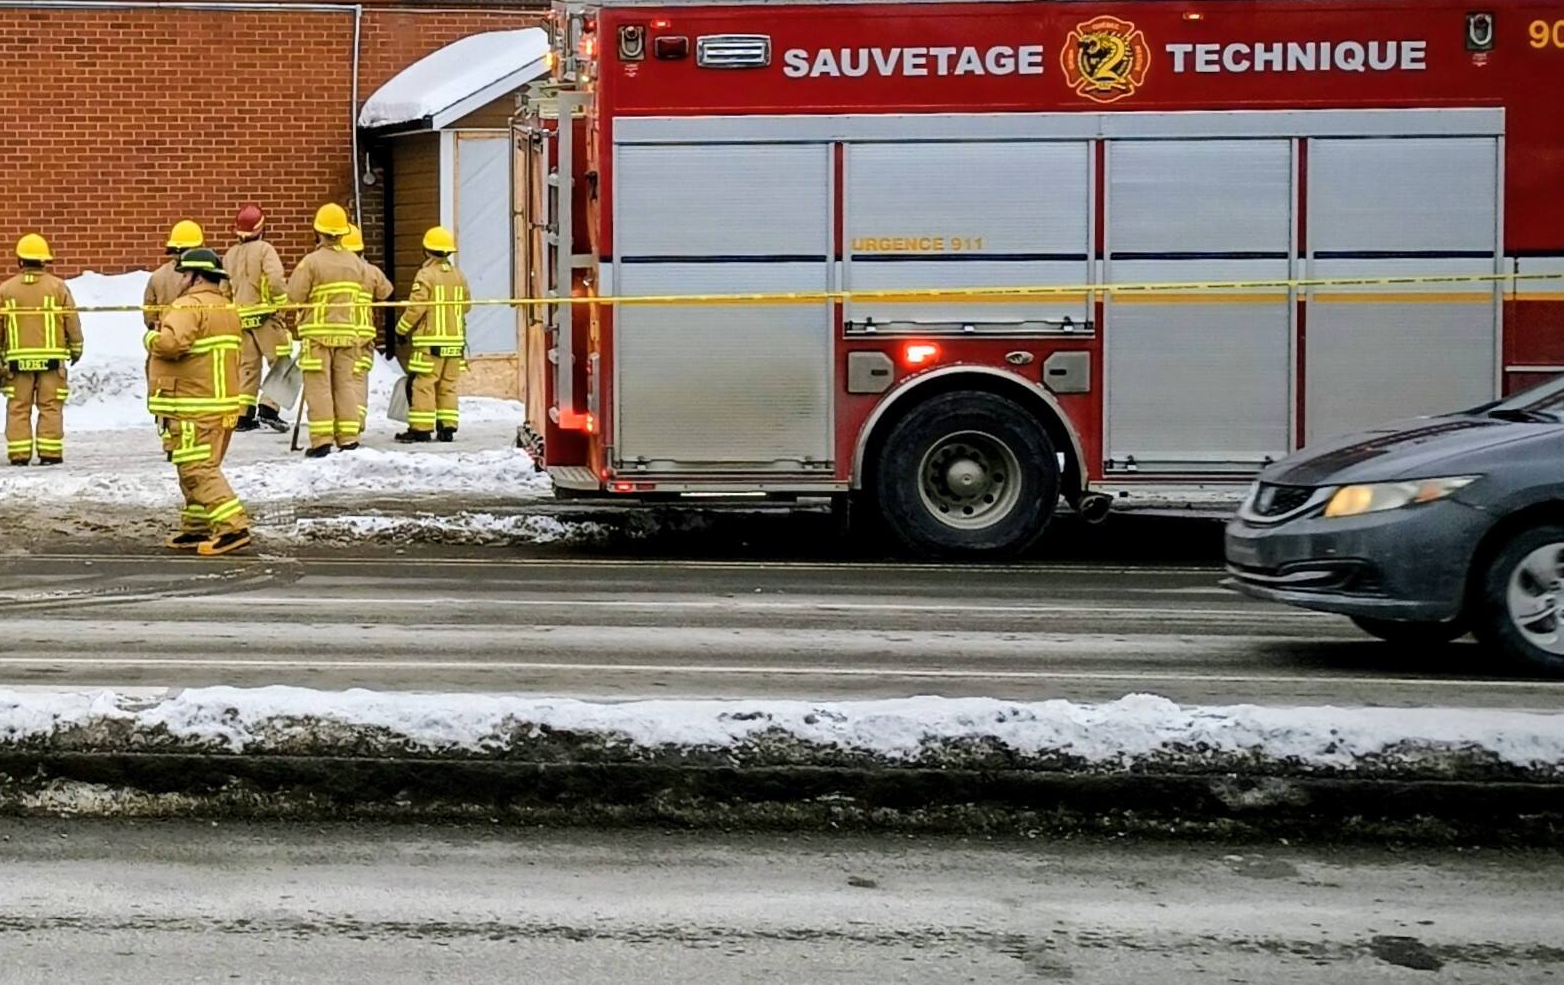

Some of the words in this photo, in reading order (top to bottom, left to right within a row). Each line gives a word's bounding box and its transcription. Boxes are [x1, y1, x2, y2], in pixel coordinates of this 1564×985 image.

[783, 45, 1044, 78] SAUVETAGE
[1166, 40, 1427, 73] TECHNIQUE
[851, 237, 945, 251] URGENCE
[950, 237, 983, 251] 911
